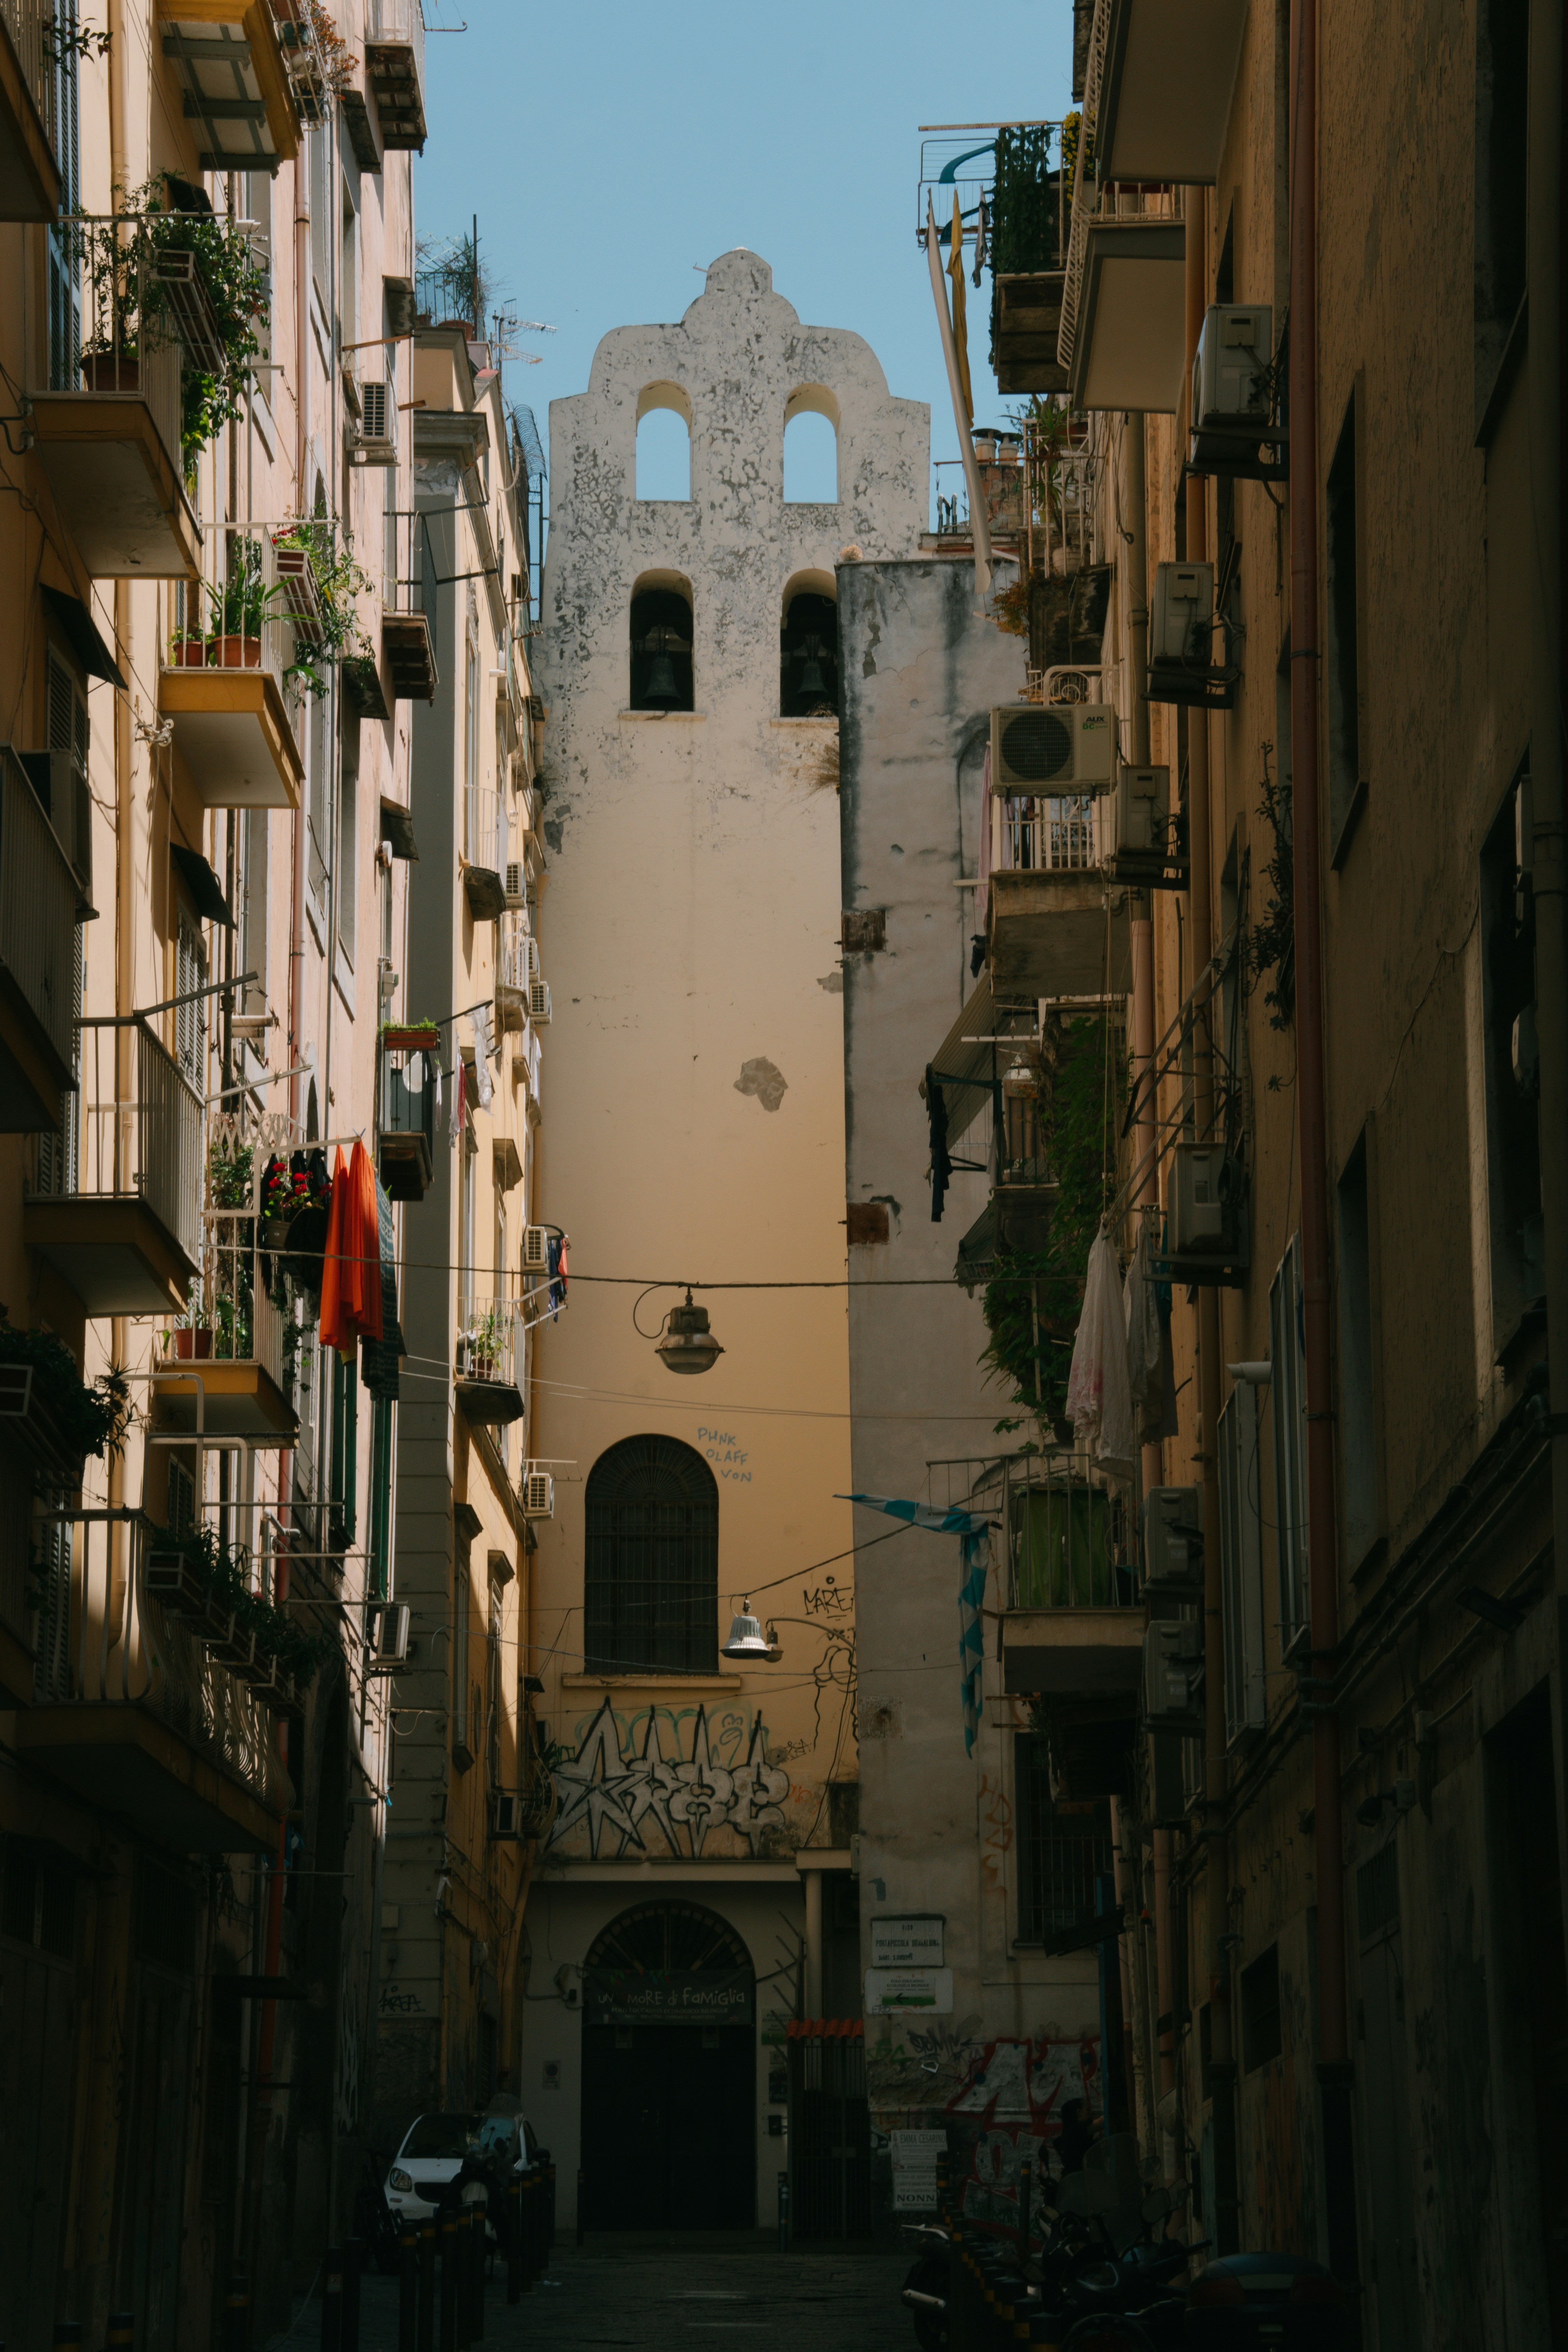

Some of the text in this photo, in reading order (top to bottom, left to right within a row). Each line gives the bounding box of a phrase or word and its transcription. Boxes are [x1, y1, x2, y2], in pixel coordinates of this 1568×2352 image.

[706, 1448, 749, 1466] OLAFF
[720, 1469, 752, 1482] VON
[668, 1989, 678, 2006] di
[900, 2133, 945, 2143] EMMA CESARINO
